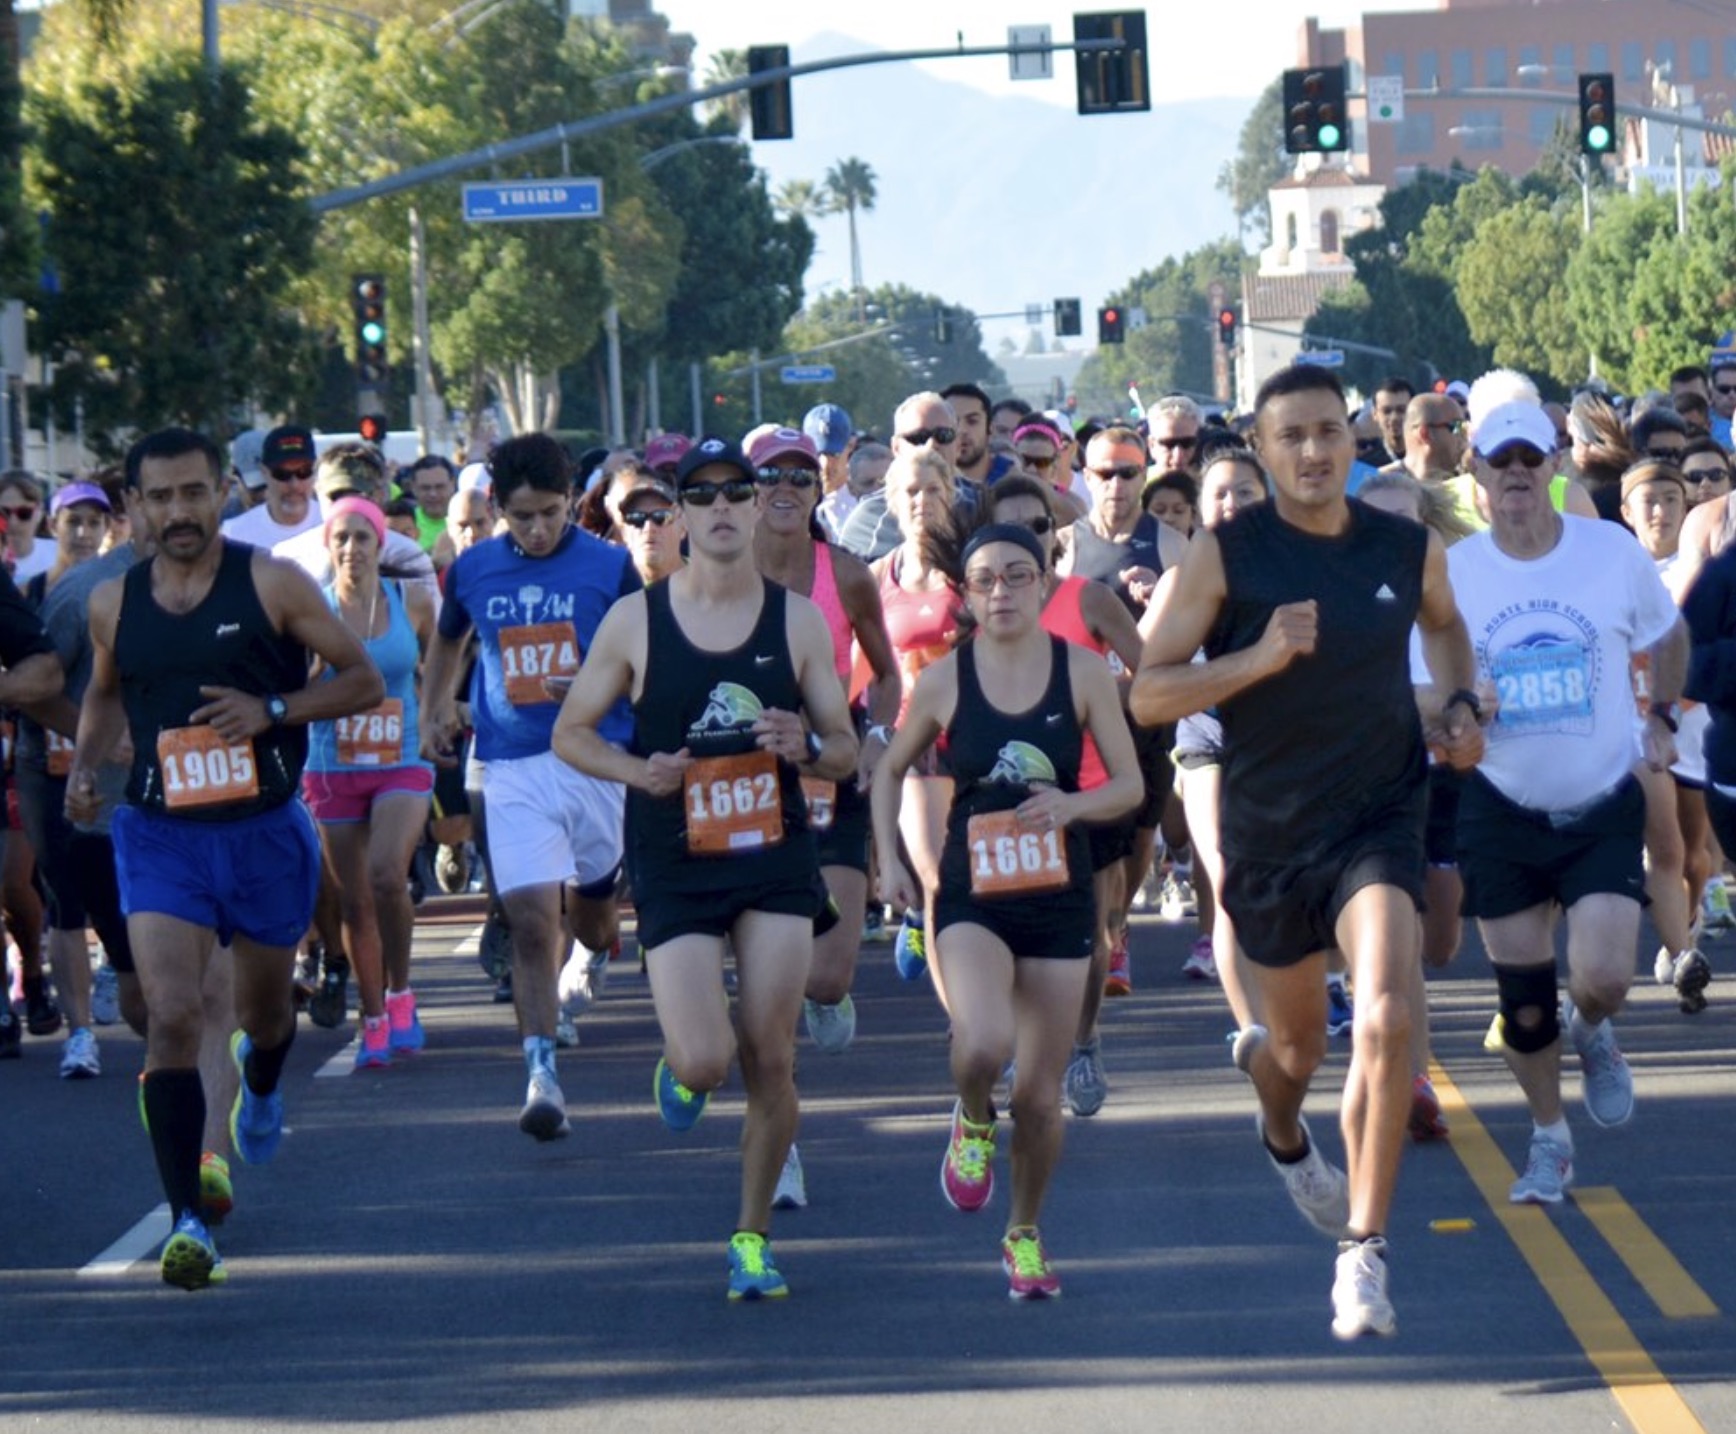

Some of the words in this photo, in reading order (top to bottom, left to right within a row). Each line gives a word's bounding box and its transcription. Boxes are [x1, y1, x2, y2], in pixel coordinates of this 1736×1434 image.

[1484, 603, 1522, 633] MONTE
[1529, 599, 1558, 610] HIGH
[503, 641, 577, 678] 1874
[1498, 668, 1584, 711] 2858
[336, 714, 400, 742] 1786
[164, 745, 253, 790] 1905
[689, 773, 777, 821] 1662
[972, 830, 1062, 876] 1661
